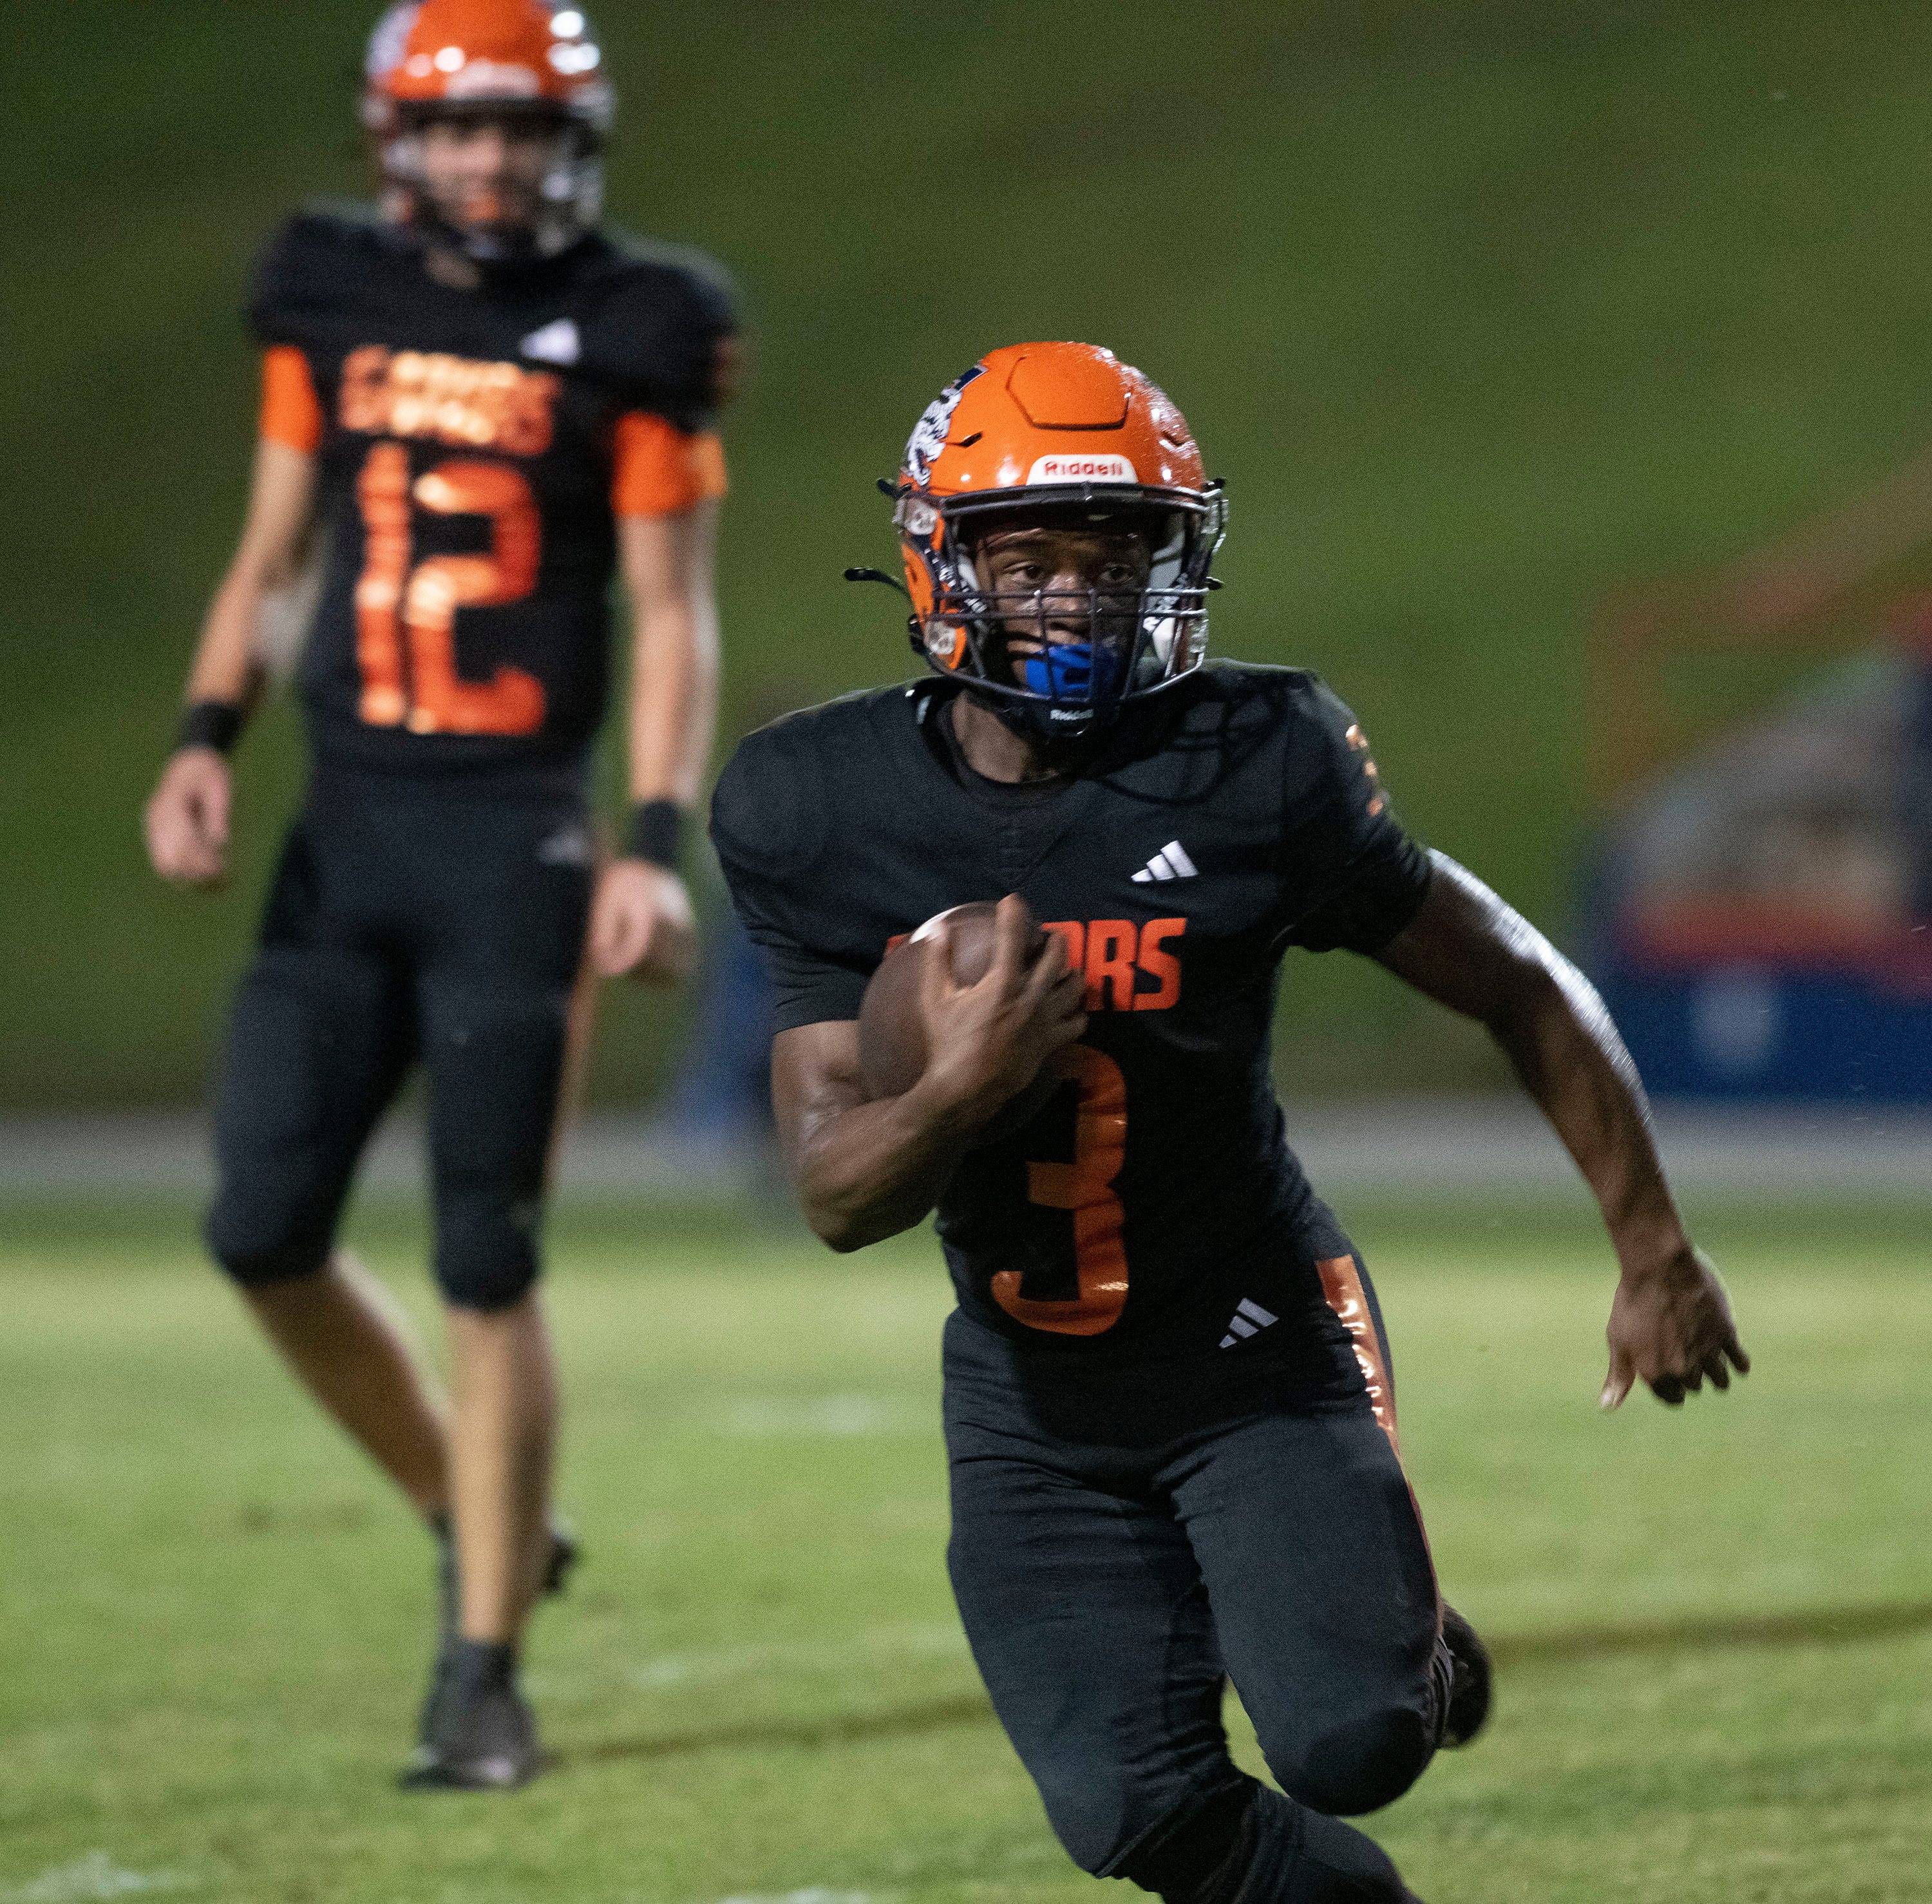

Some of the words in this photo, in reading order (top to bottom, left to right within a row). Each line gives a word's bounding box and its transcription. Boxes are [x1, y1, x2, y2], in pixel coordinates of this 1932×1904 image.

[356, 441, 546, 734] 12
[1044, 460, 1123, 475] Riddell
[990, 1043, 1128, 1336] 3
